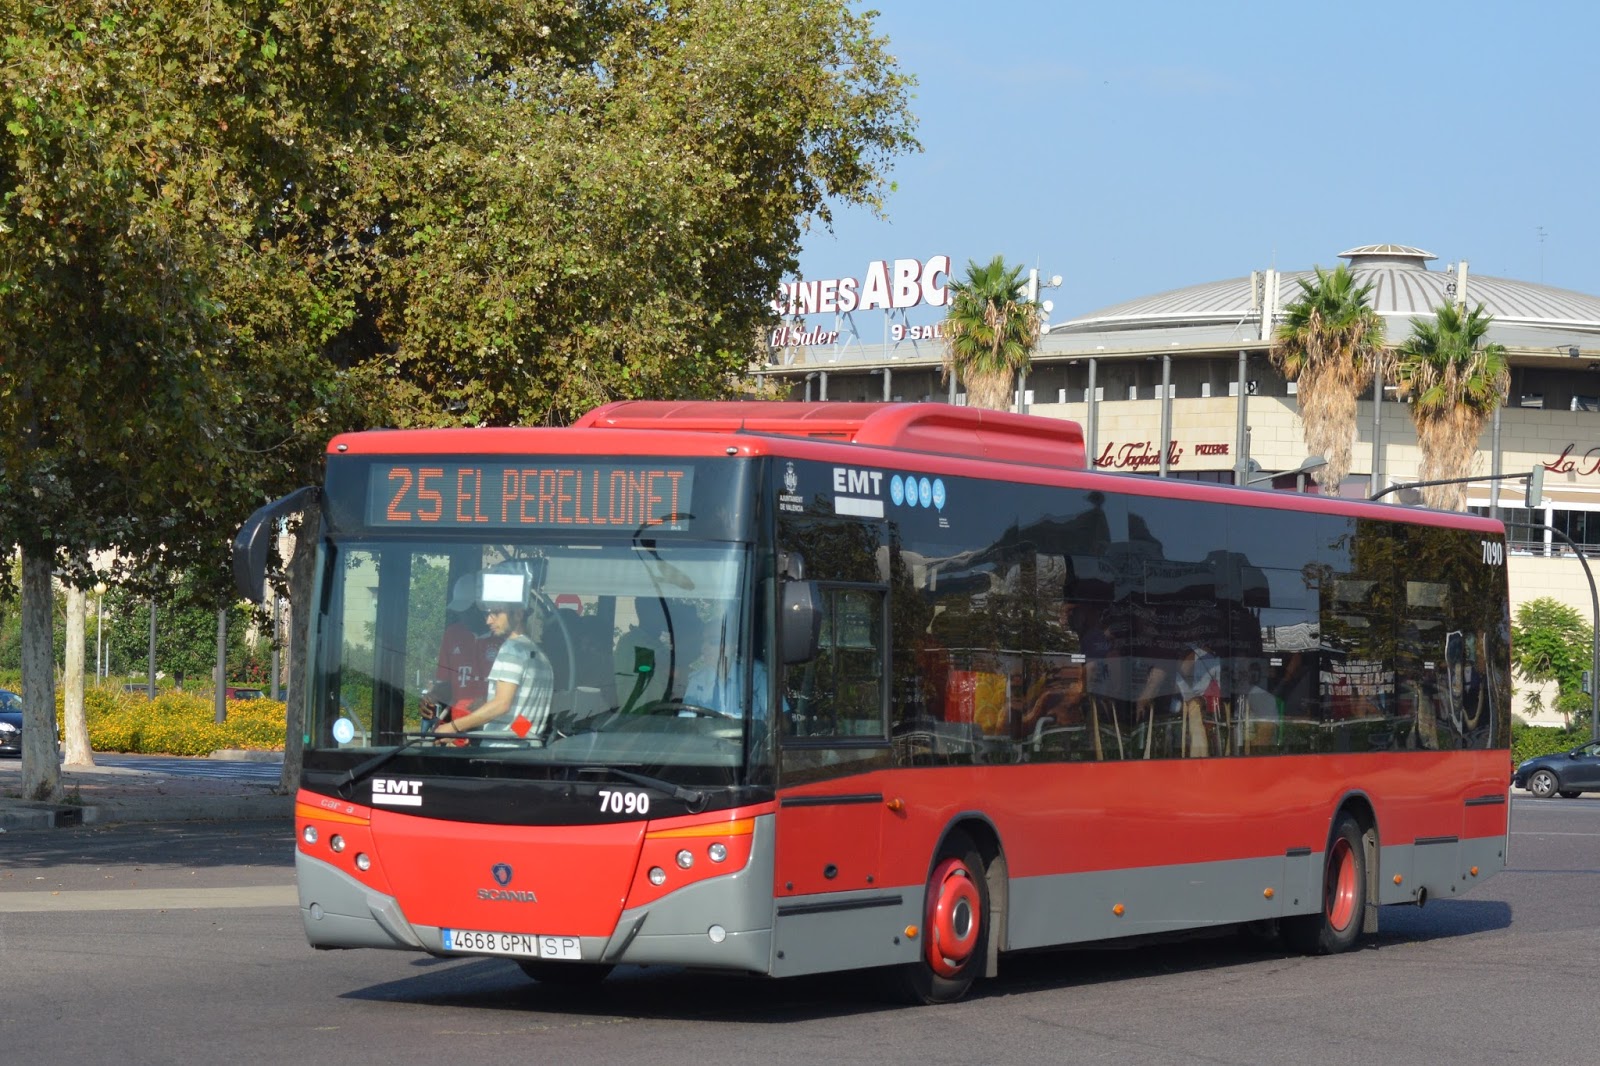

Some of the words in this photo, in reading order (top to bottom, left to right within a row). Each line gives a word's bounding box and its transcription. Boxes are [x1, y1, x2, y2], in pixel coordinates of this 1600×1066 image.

[770, 277, 859, 316] CINES
[859, 255, 950, 310] ABC
[771, 326, 789, 347] El
[791, 325, 839, 347] Saler
[891, 324, 906, 341] 9
[911, 325, 944, 340] SAL
[1093, 441, 1114, 467] La
[1114, 441, 1183, 471] Tagliatlla
[1542, 443, 1575, 474] La
[833, 468, 883, 495] EMT
[387, 468, 443, 521] 25
[457, 469, 488, 522] EL
[502, 470, 683, 525] PERELLONET
[1481, 540, 1503, 566] 7090
[372, 779, 423, 795] EMT
[599, 791, 650, 814] 7090
[477, 888, 538, 904] SCANIA
[454, 931, 496, 950] 4668
[501, 934, 533, 953] GPN
